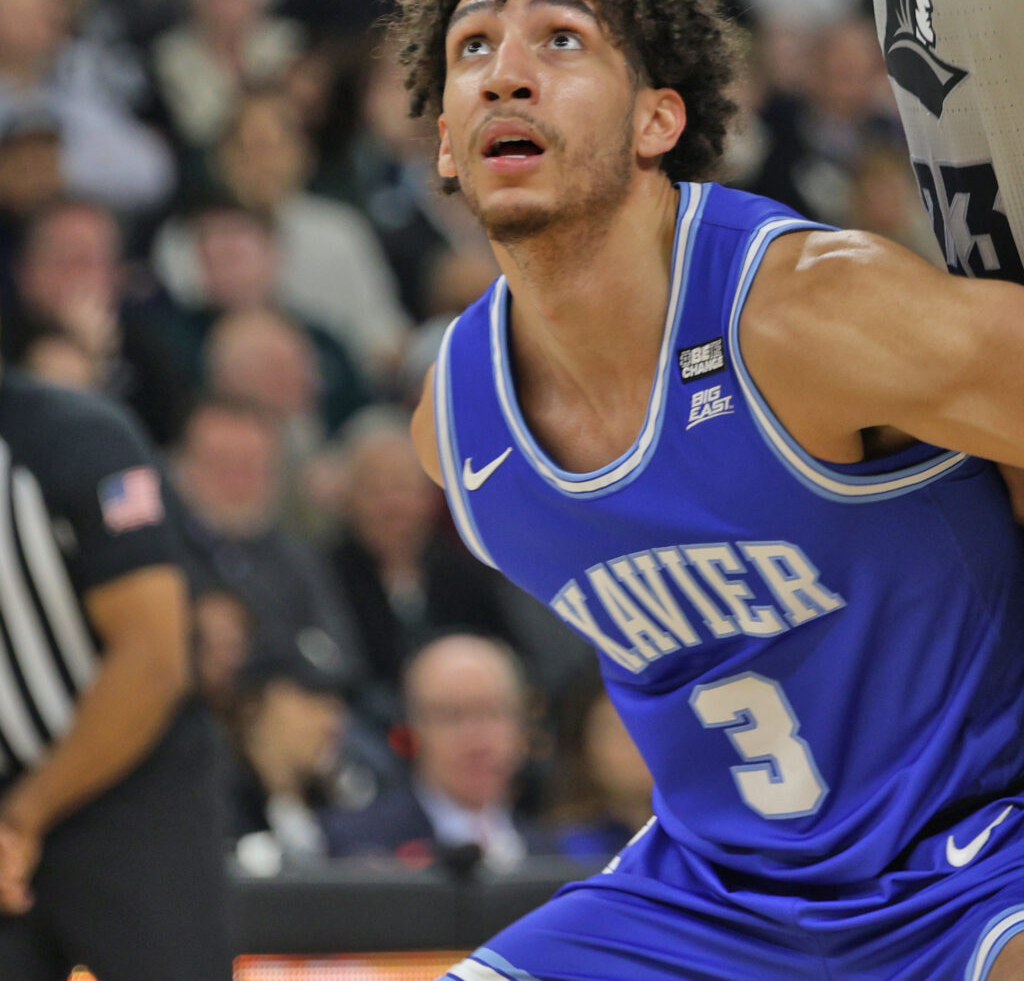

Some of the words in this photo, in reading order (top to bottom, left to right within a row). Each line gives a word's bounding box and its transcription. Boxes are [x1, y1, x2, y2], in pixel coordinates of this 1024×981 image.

[691, 343, 711, 364] BE
[681, 356, 724, 379] CHANGE
[688, 395, 732, 422] EAST
[691, 385, 721, 408] BIG
[549, 540, 847, 674] XAVIER
[688, 670, 830, 819] 3
